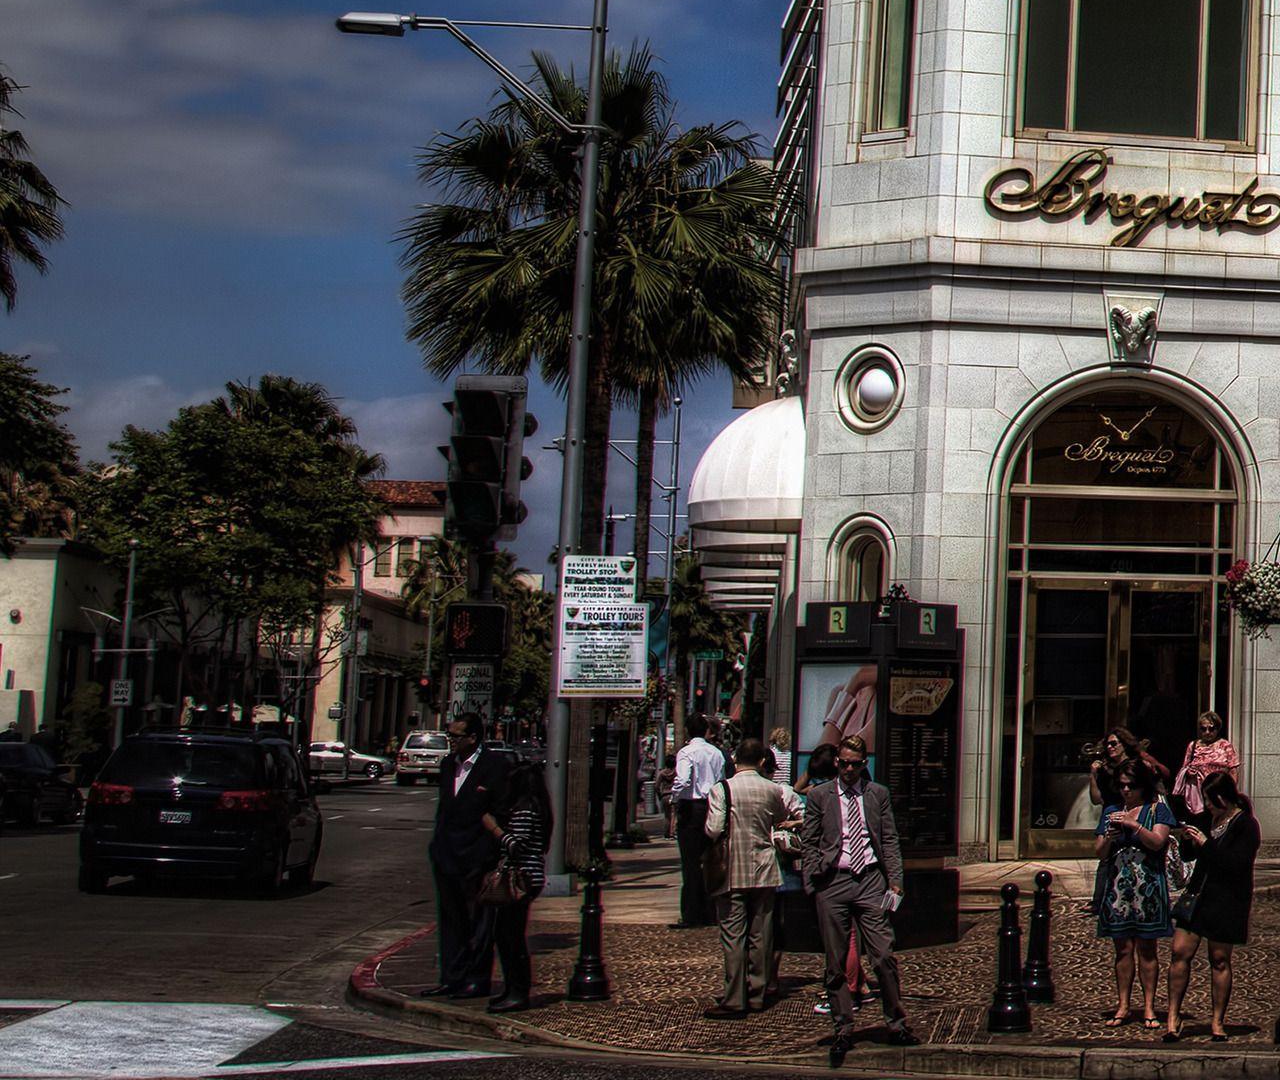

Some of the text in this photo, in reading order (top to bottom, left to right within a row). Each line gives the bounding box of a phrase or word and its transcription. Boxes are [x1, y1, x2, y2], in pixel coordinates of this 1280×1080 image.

[1065, 436, 1174, 473] Breguet
[583, 612, 645, 621] TROLLEY TOURS
[456, 667, 491, 678] DIAGONAL
[454, 681, 492, 692] CROSSING
